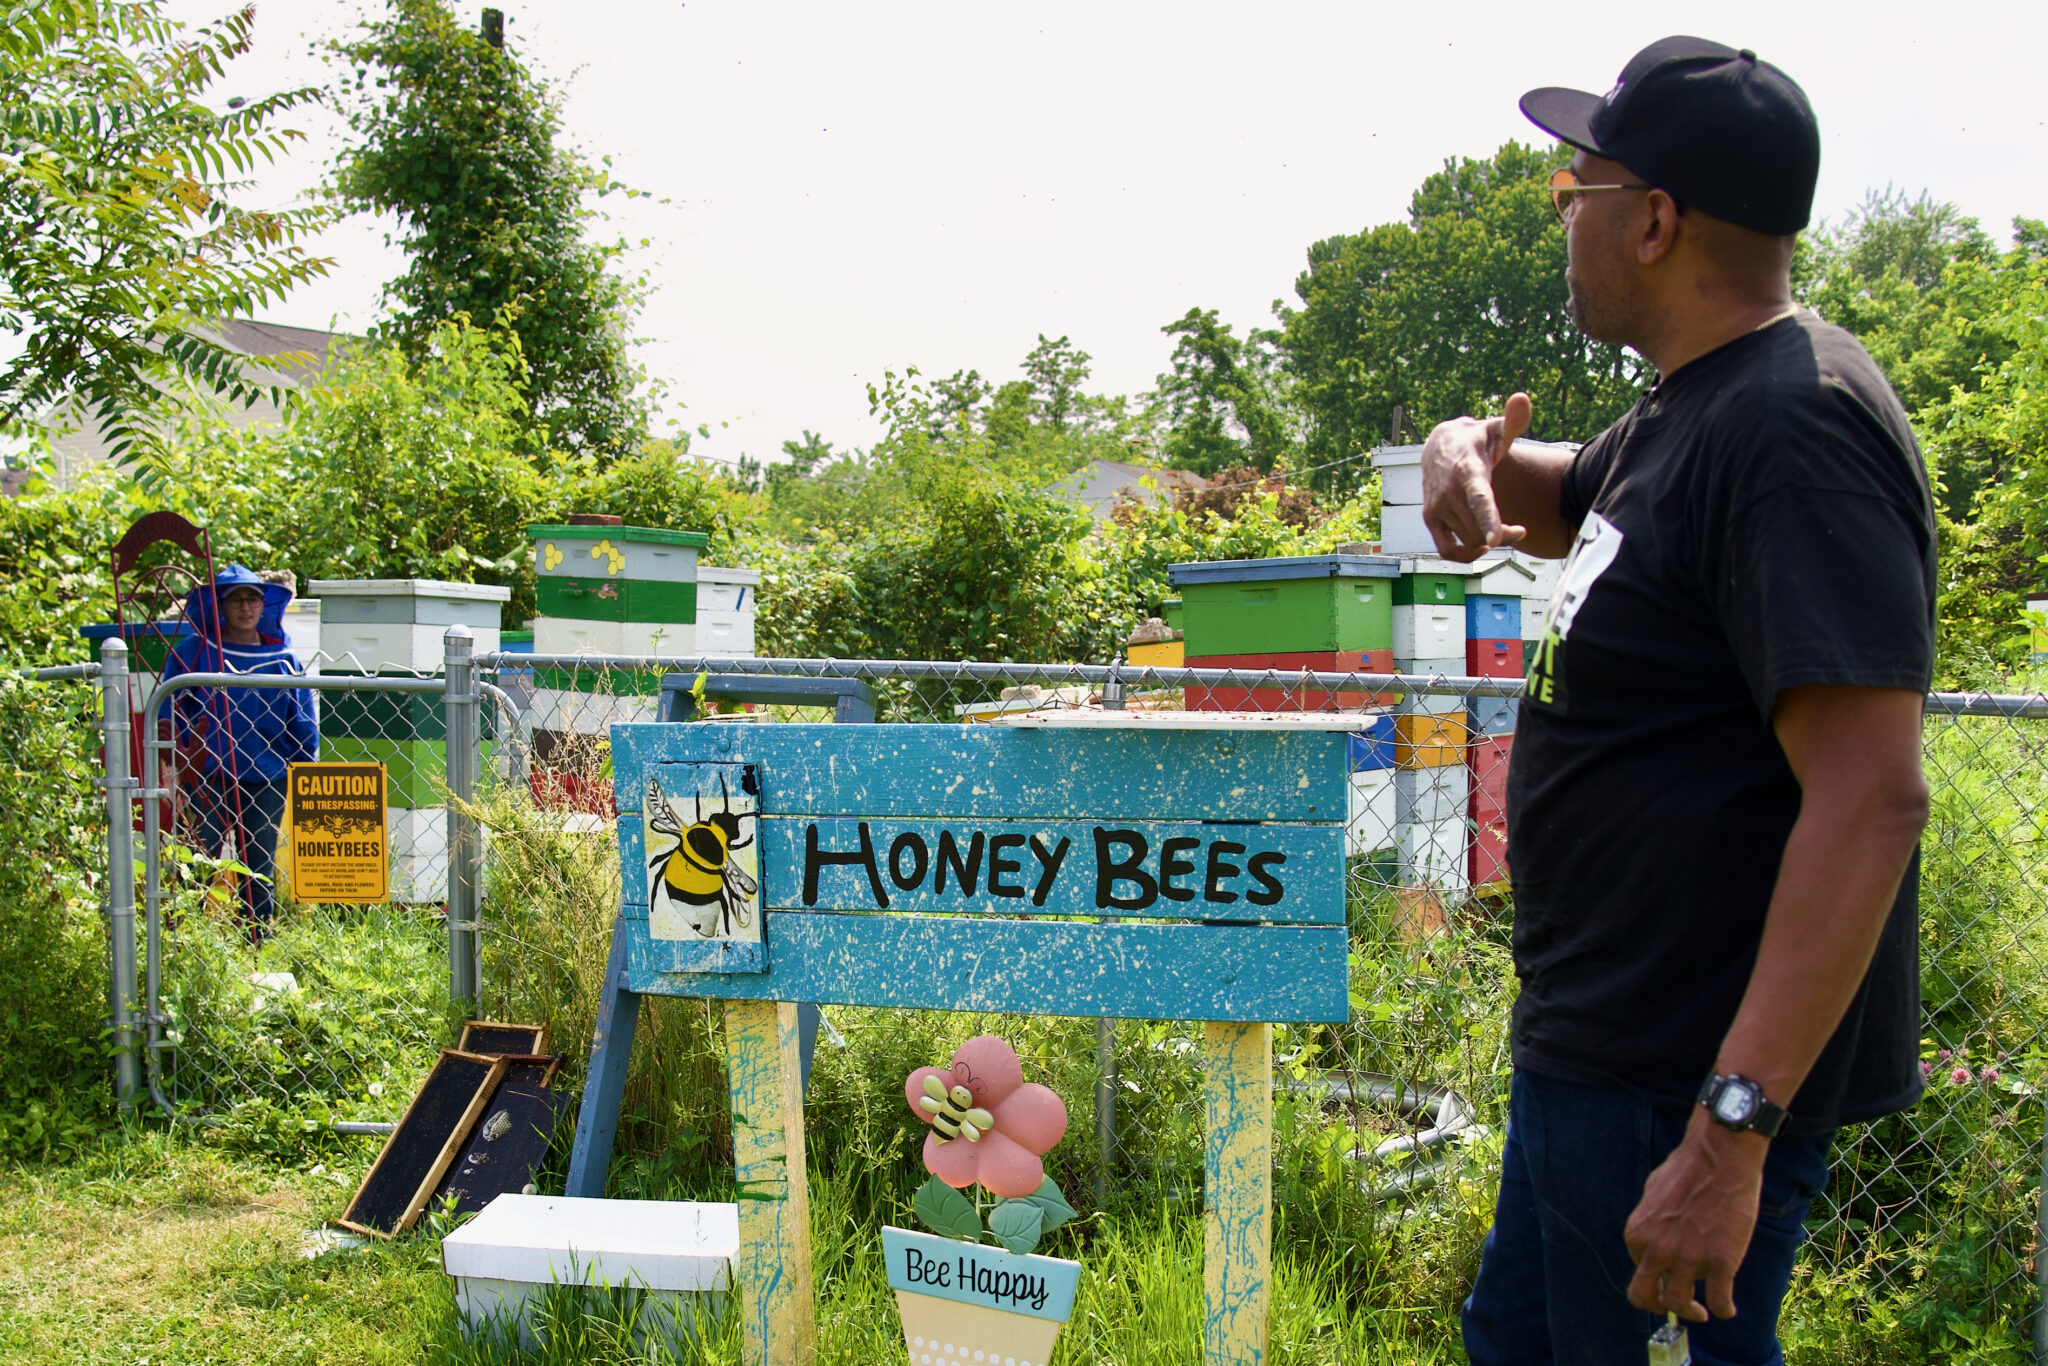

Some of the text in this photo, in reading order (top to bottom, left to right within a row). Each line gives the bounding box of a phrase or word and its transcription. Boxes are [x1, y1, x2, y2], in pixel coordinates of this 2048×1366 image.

[297, 775, 377, 796] CAUTION
[302, 800, 315, 810] NO
[297, 841, 380, 857] HONEYBEES
[802, 822, 1287, 910] HONEY BEES
[905, 1248, 1049, 1310] Bee Happy
